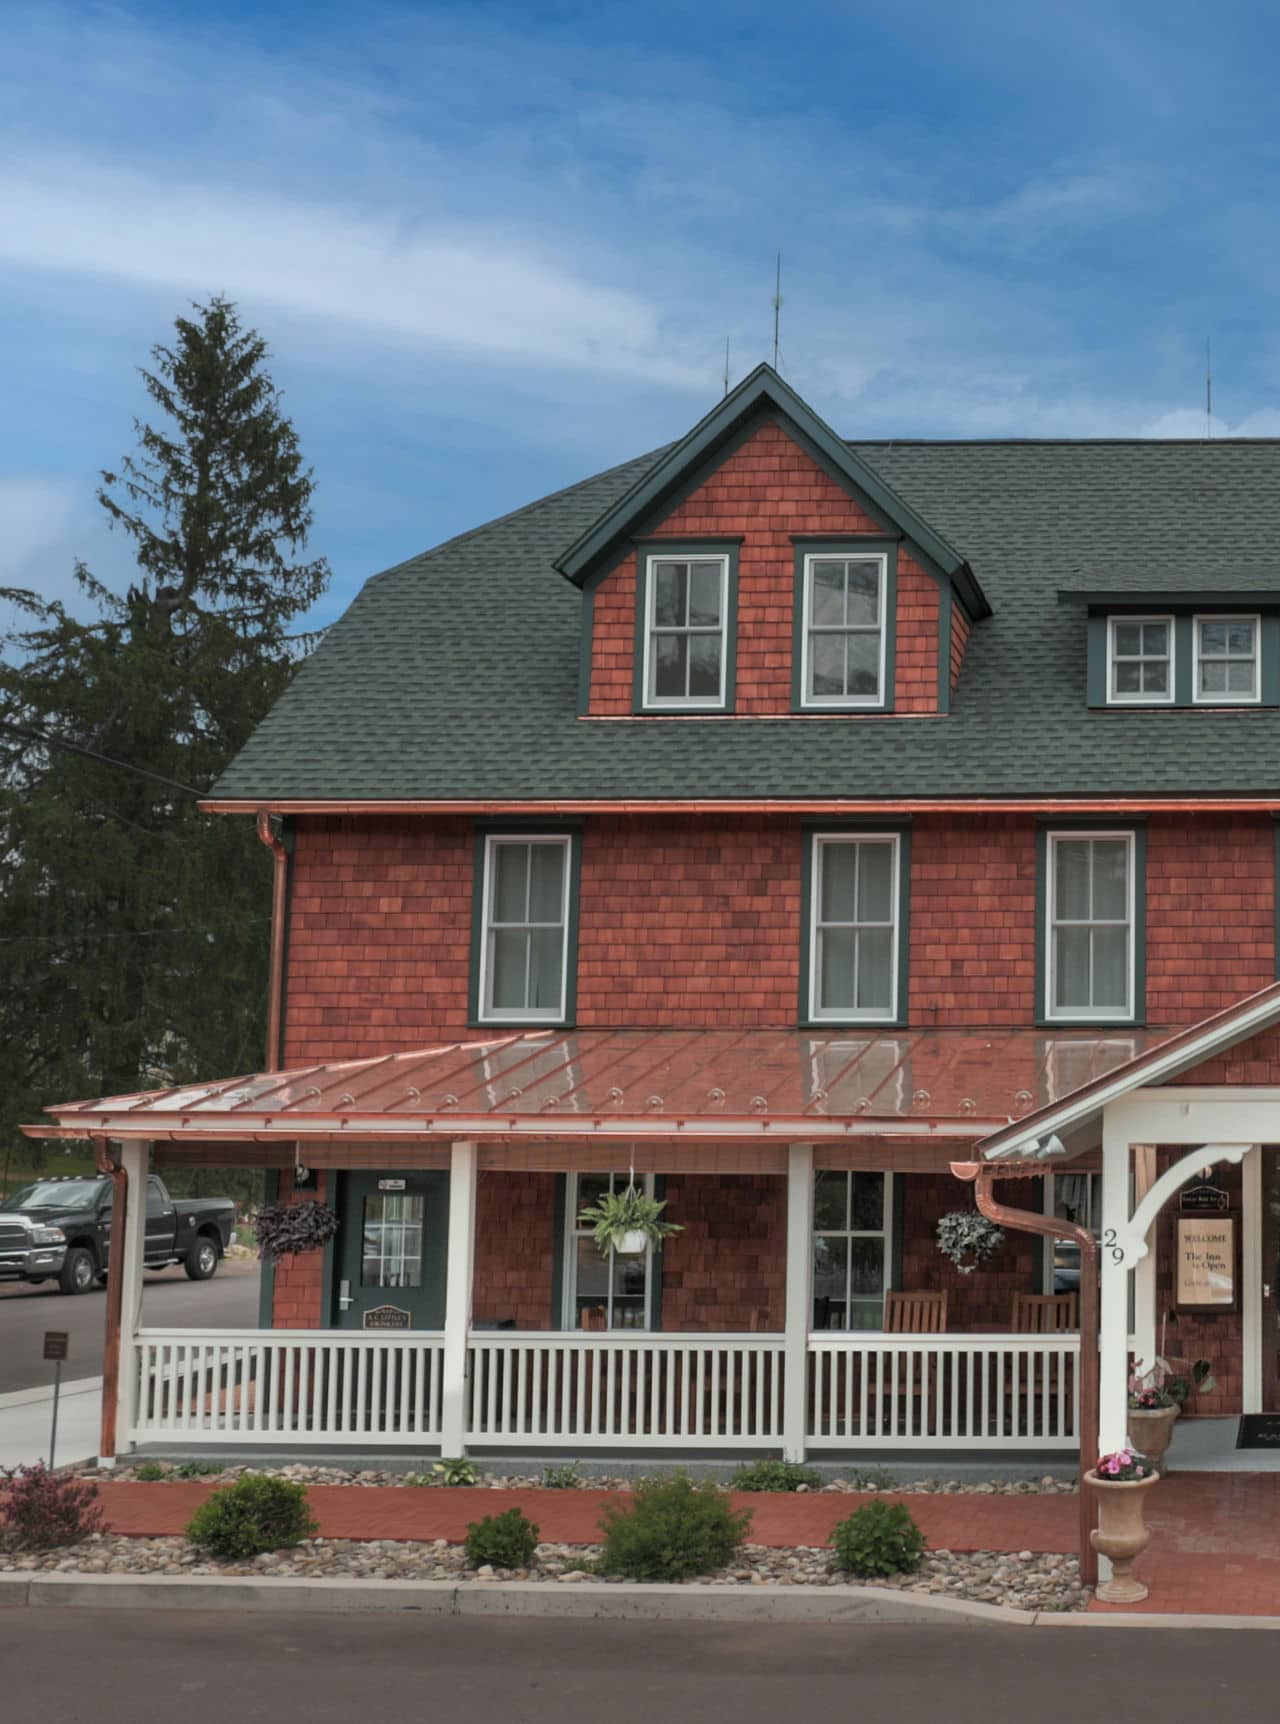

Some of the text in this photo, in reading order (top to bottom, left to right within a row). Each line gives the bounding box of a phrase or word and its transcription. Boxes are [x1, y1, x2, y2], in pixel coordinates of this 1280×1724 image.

[1104, 1228, 1124, 1266] 29
[1185, 1251, 1221, 1261] The Inn
[1201, 1263, 1226, 1272] Open
